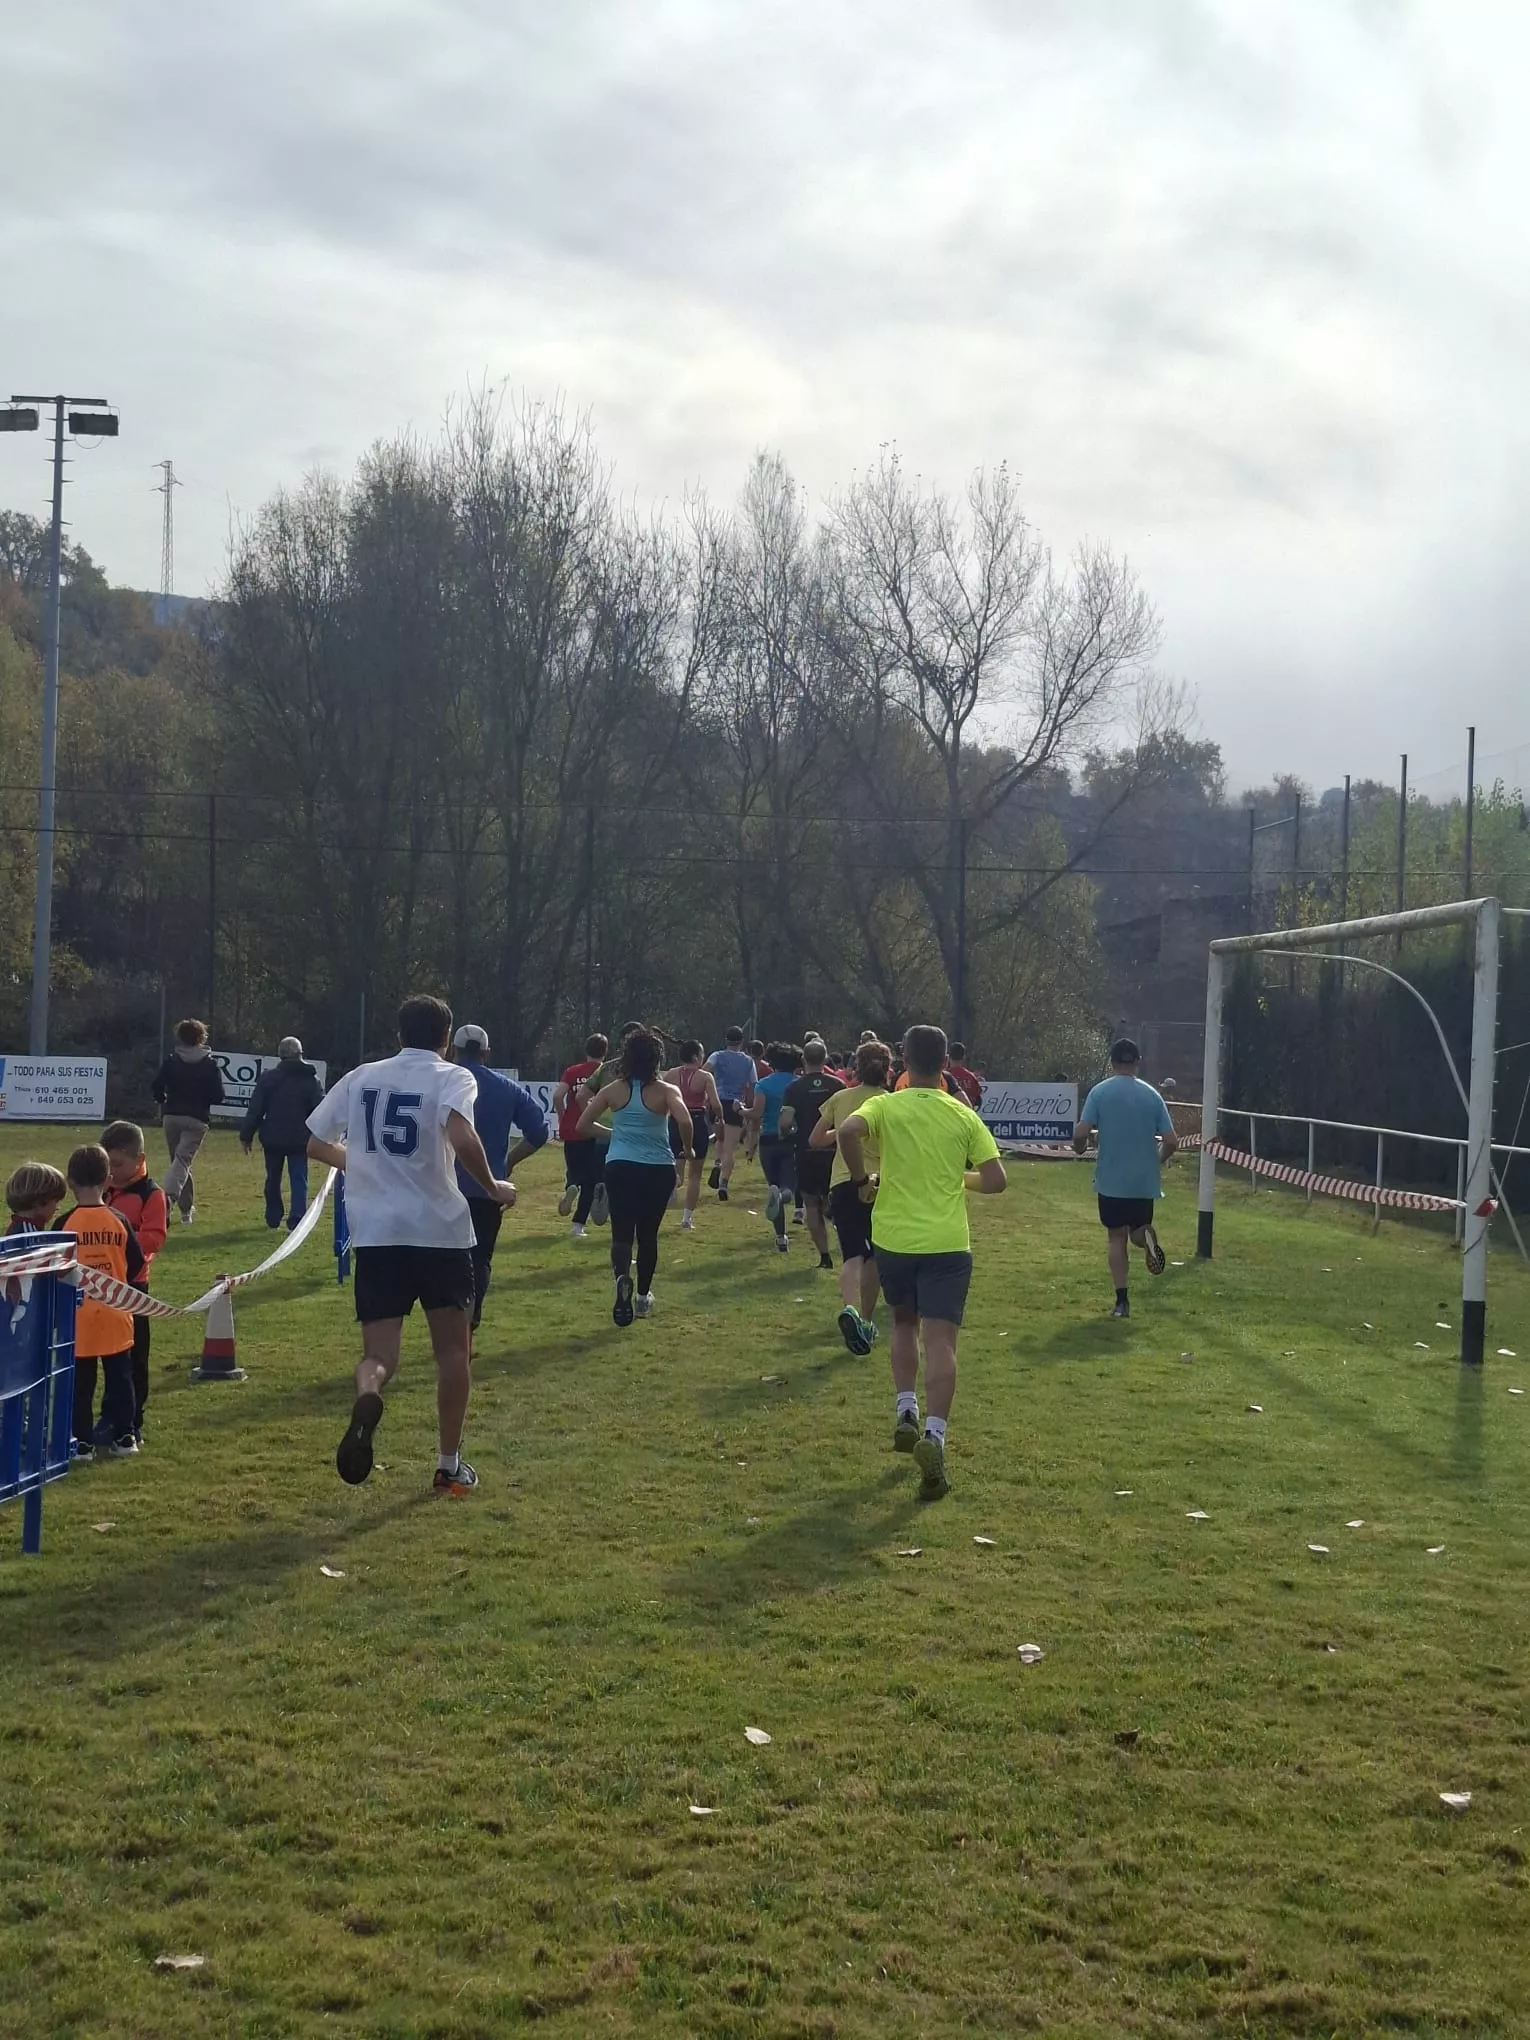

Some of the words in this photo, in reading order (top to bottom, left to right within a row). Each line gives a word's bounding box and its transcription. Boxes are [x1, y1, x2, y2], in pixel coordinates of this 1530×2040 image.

[14, 1066, 34, 1077] TODO
[36, 1067, 55, 1077] PARA
[57, 1067, 73, 1077] SUS
[74, 1067, 104, 1078] FIESTAS
[35, 1086, 49, 1094] 610
[361, 1088, 424, 1158] 15
[993, 1123, 1012, 1137] del
[1016, 1122, 1058, 1137] turbón
